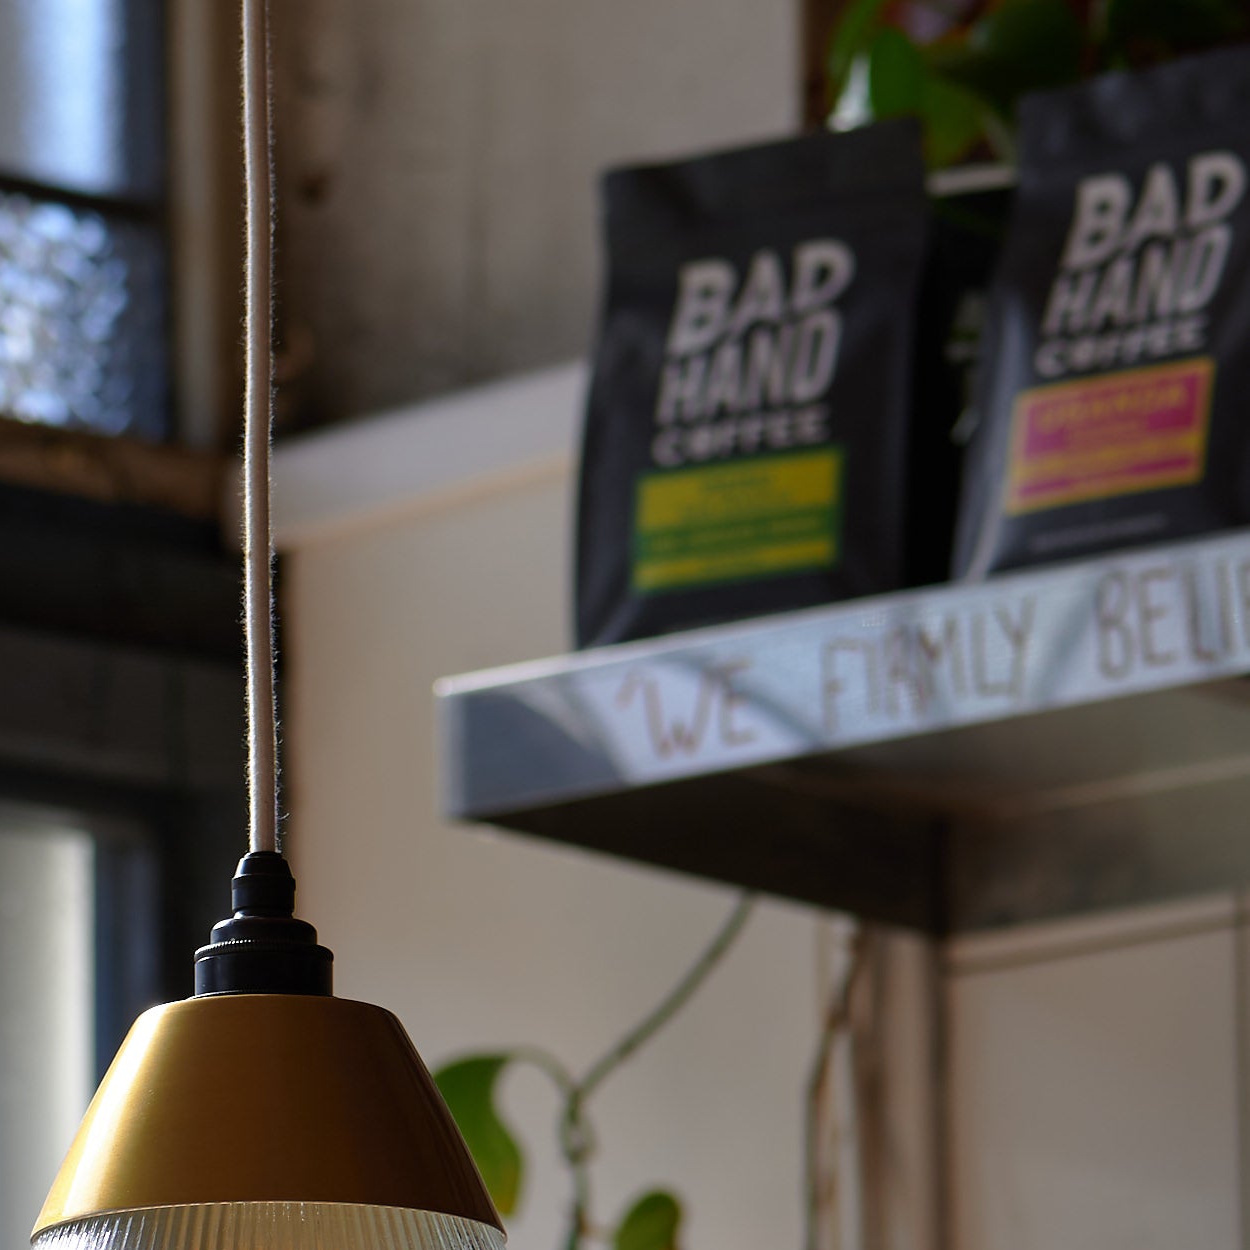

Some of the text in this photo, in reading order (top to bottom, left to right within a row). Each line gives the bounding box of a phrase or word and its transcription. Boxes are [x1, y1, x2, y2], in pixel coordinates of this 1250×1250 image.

[1067, 153, 1247, 269] BAD
[672, 240, 855, 355] BAD
[1045, 226, 1231, 332] HAND
[658, 312, 841, 422] HAND
[1036, 319, 1207, 375] COFFEE
[652, 407, 829, 465] COFFEE
[823, 601, 1037, 731] FIRMLY
